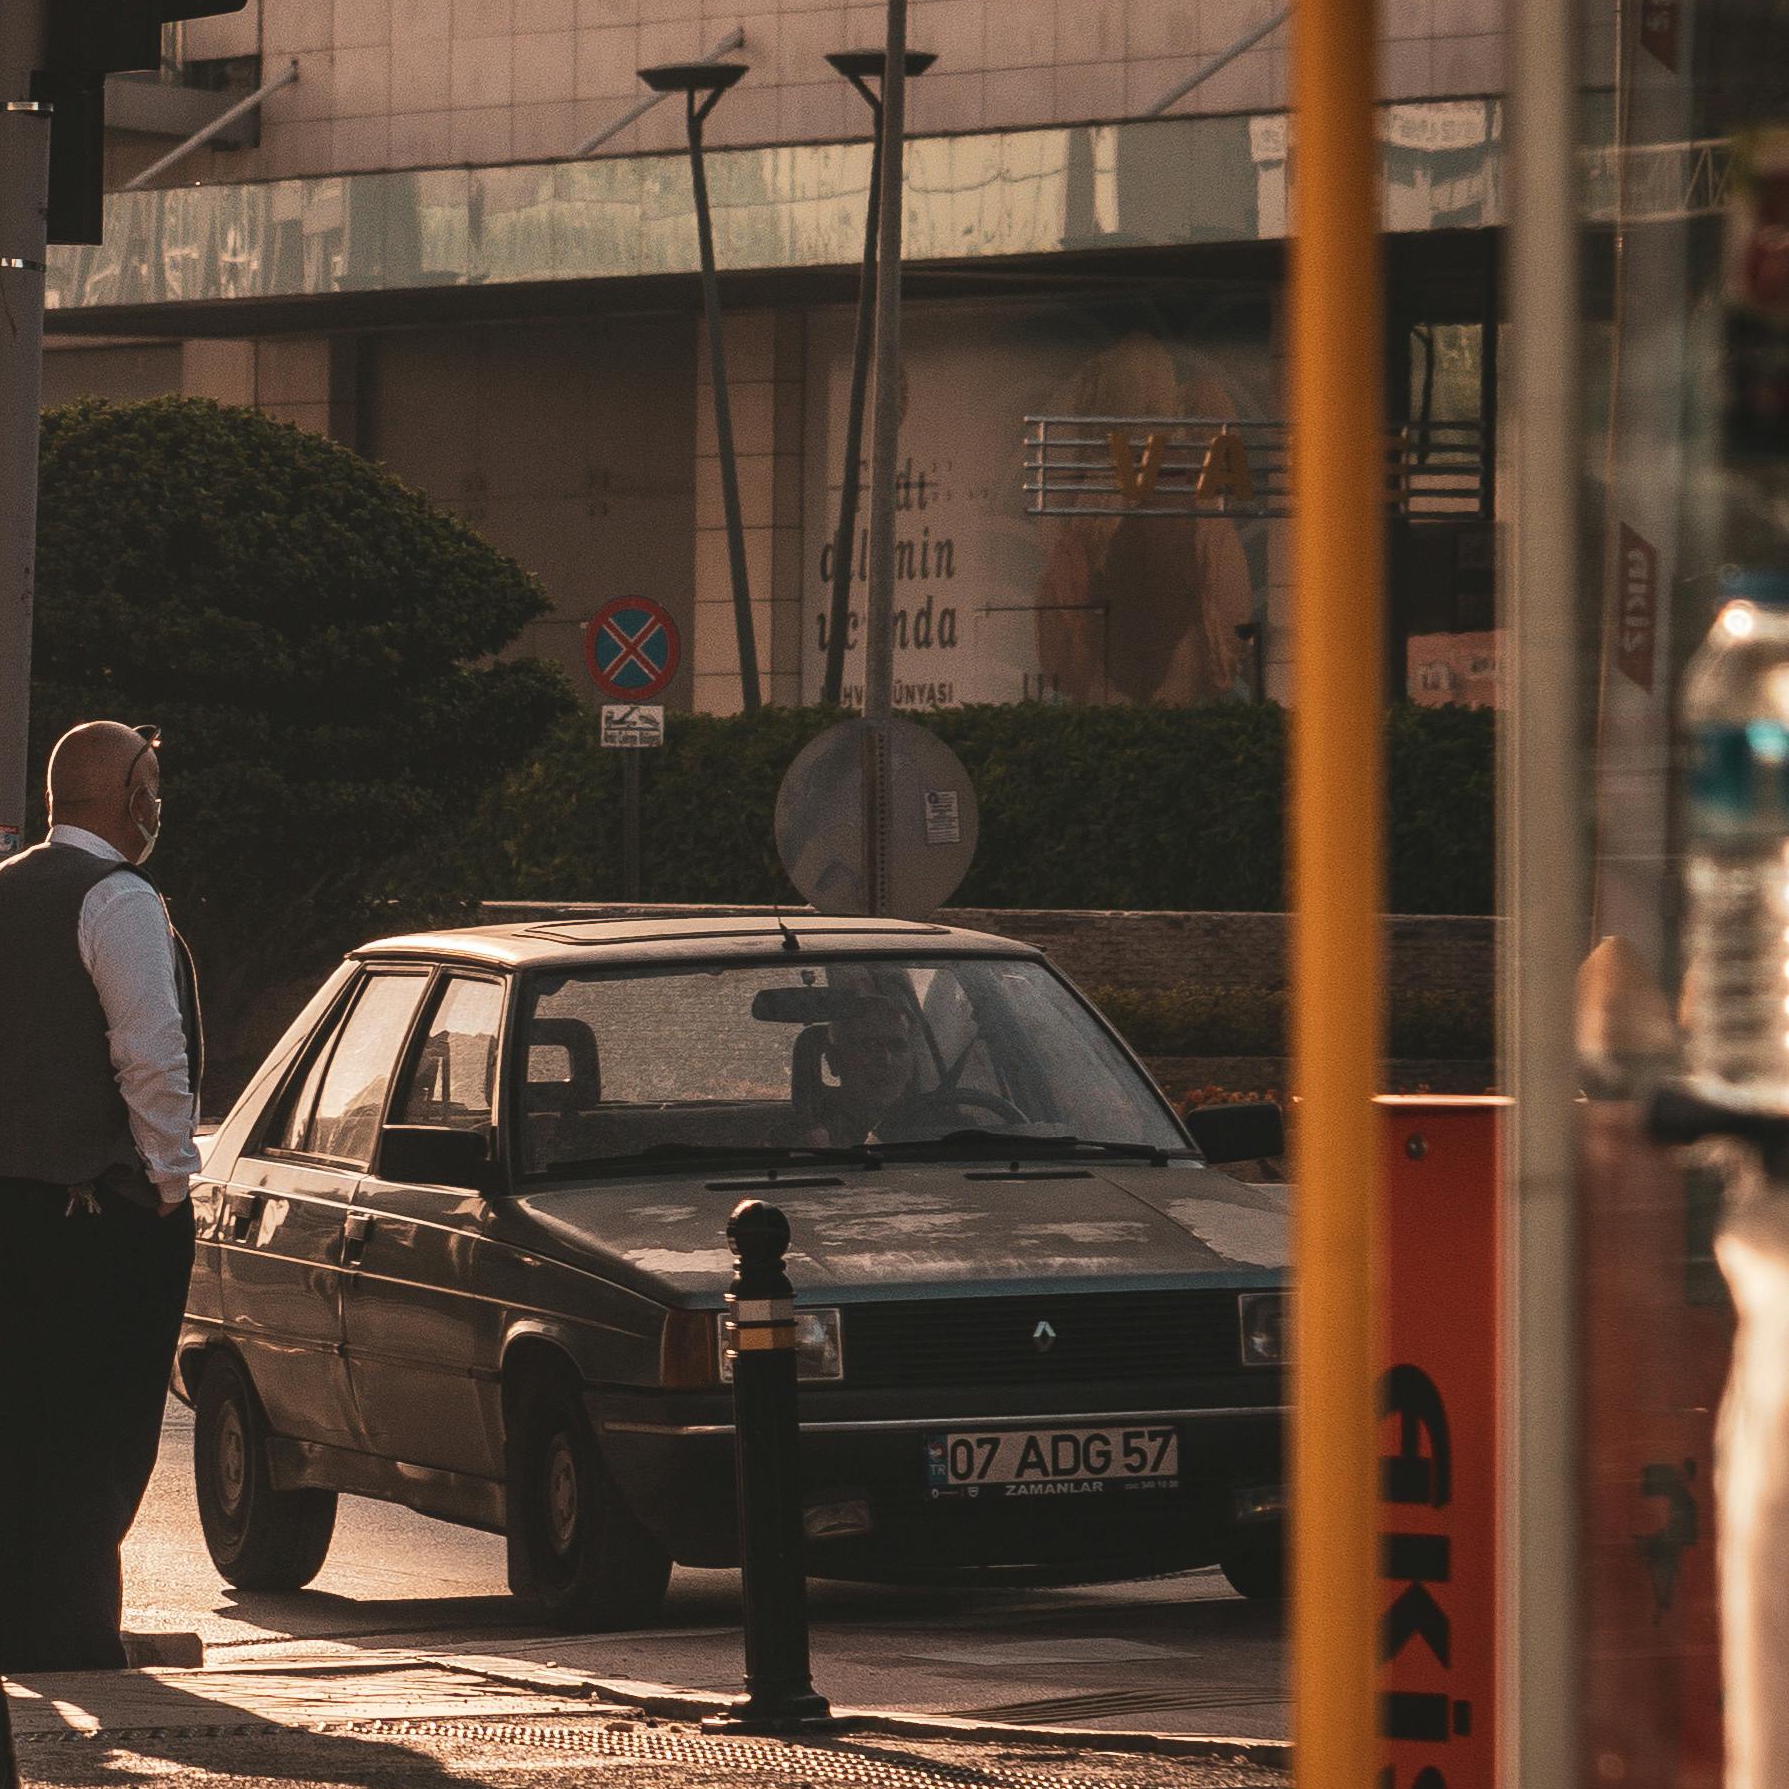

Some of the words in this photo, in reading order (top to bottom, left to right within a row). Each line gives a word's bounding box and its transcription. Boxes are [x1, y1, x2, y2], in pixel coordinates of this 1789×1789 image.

[892, 679, 953, 706] ÜNYASI
[950, 1436, 1001, 1481] 07
[1014, 1432, 1113, 1478] ADG
[1122, 1429, 1173, 1474] 57
[930, 1464, 947, 1476] TR
[1004, 1481, 1105, 1497] ZAMANLAR
